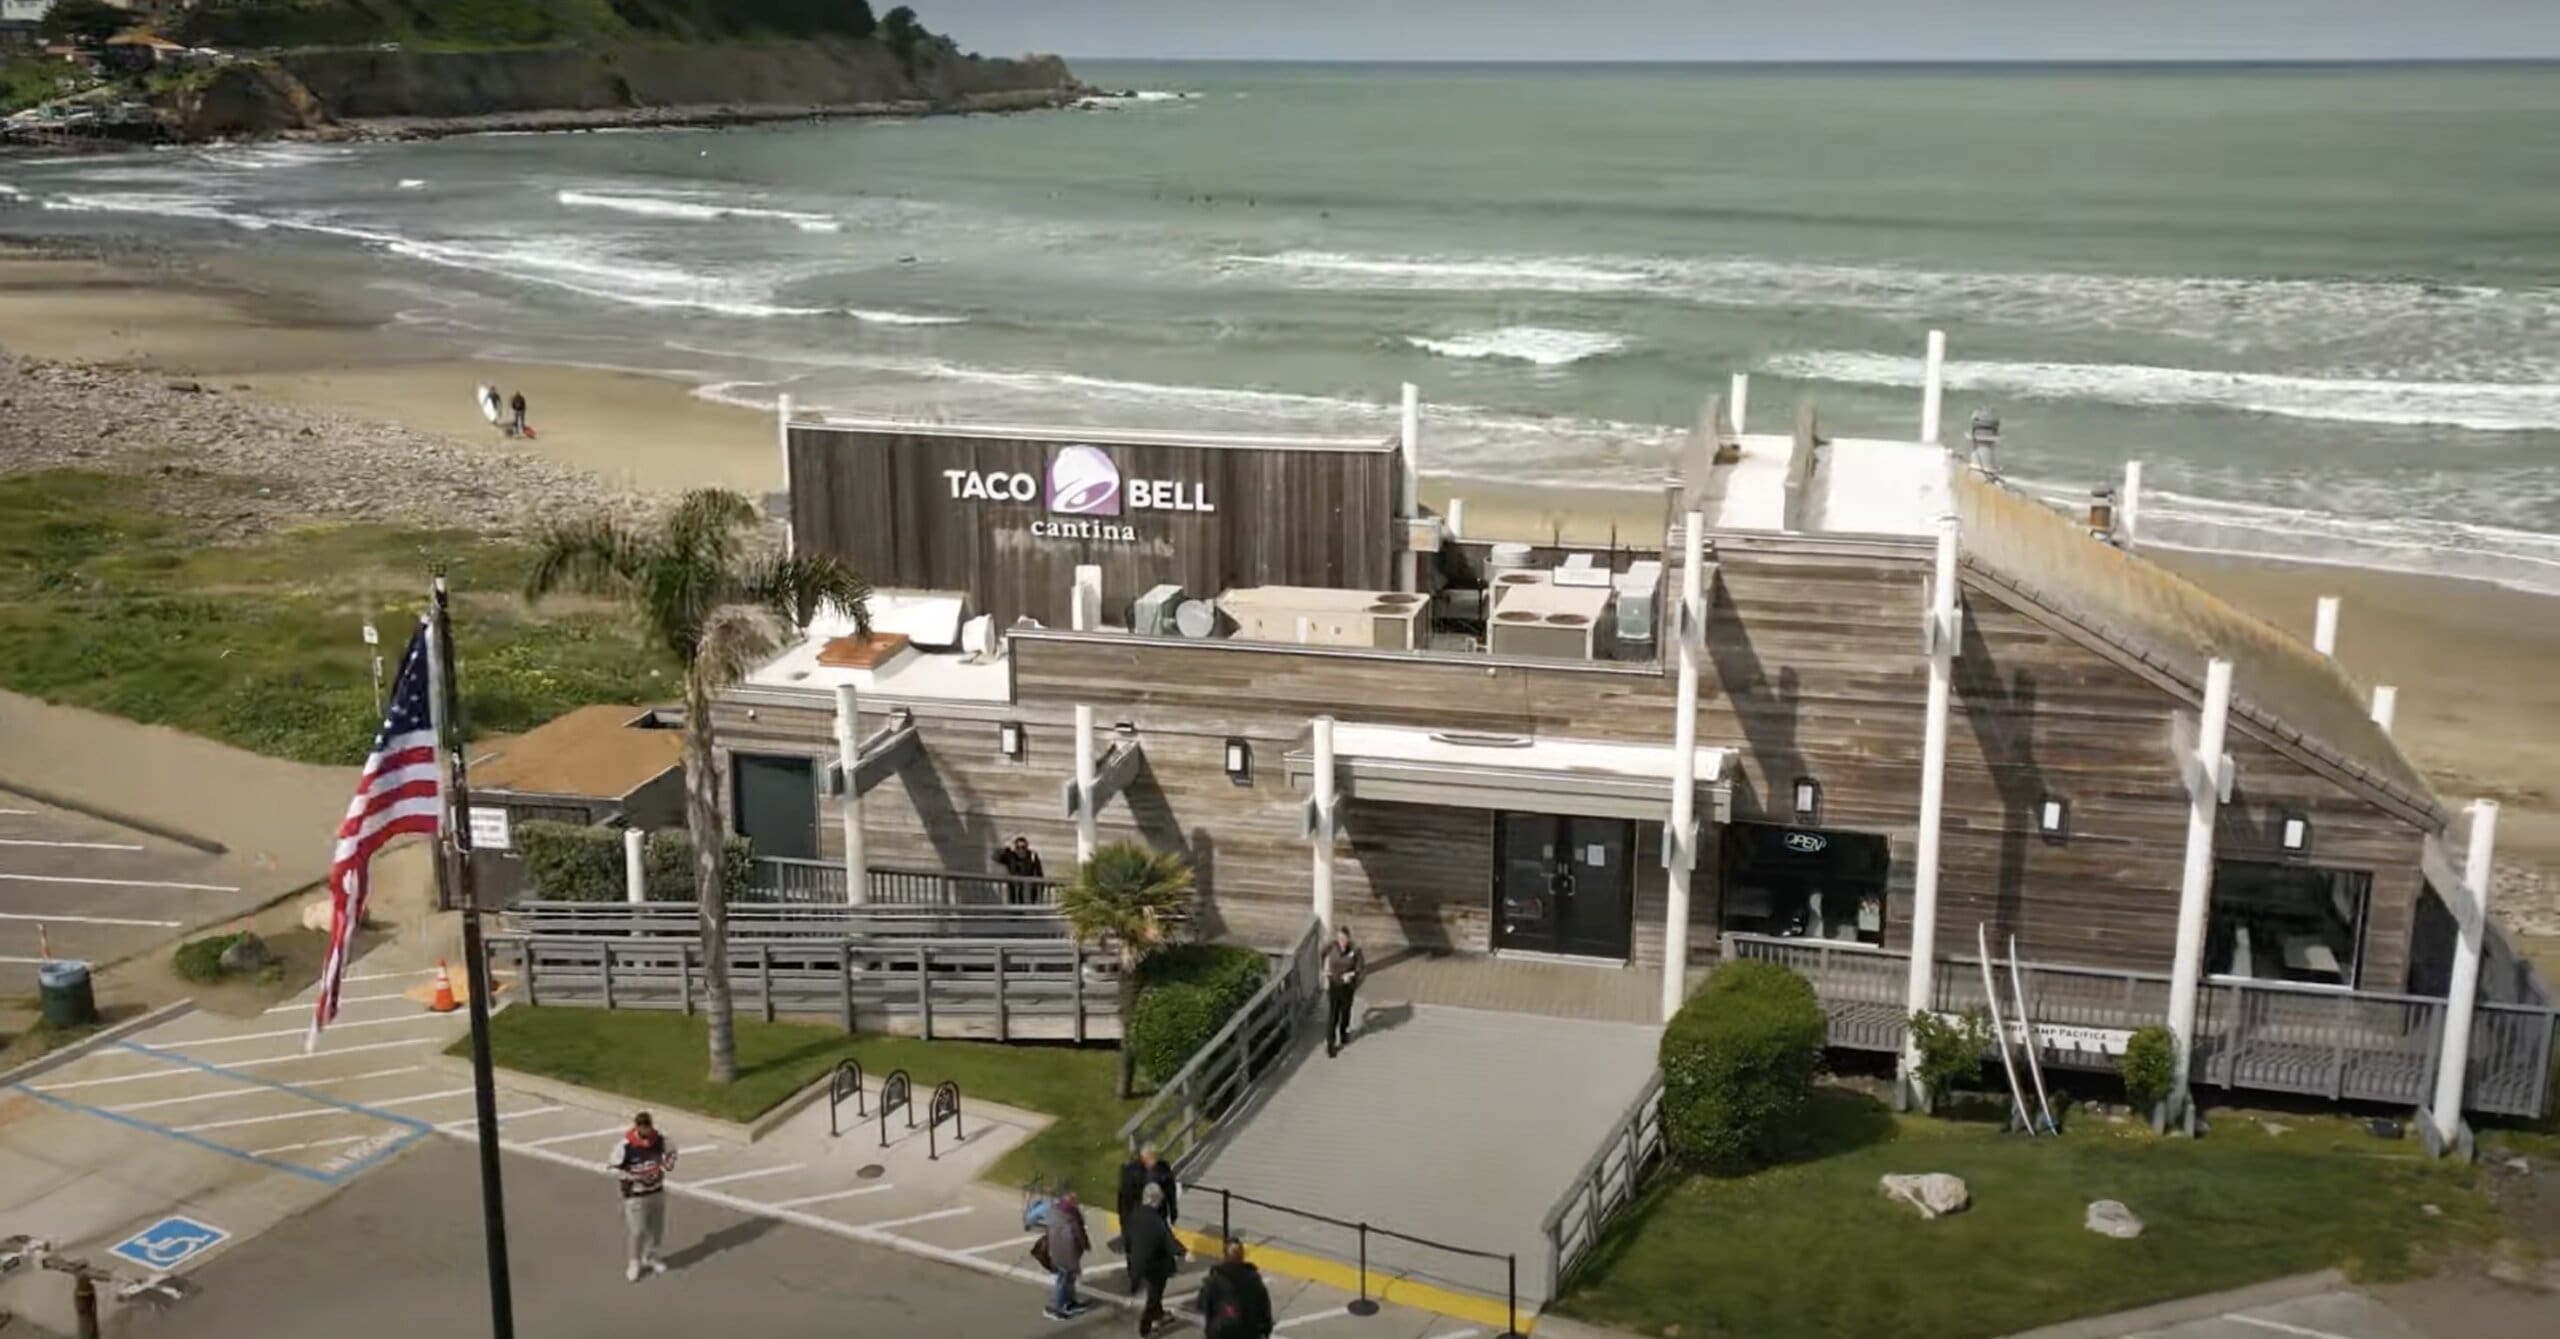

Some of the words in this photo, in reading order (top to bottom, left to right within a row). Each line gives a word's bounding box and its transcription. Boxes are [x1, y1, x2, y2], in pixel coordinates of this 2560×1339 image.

[944, 470, 1037, 501] TACO
[1129, 479, 1215, 512] BELL
[1030, 520, 1136, 541] cantina
[1785, 832, 1823, 851] OPEN
[2059, 1028, 2107, 1040] PACIFICA
